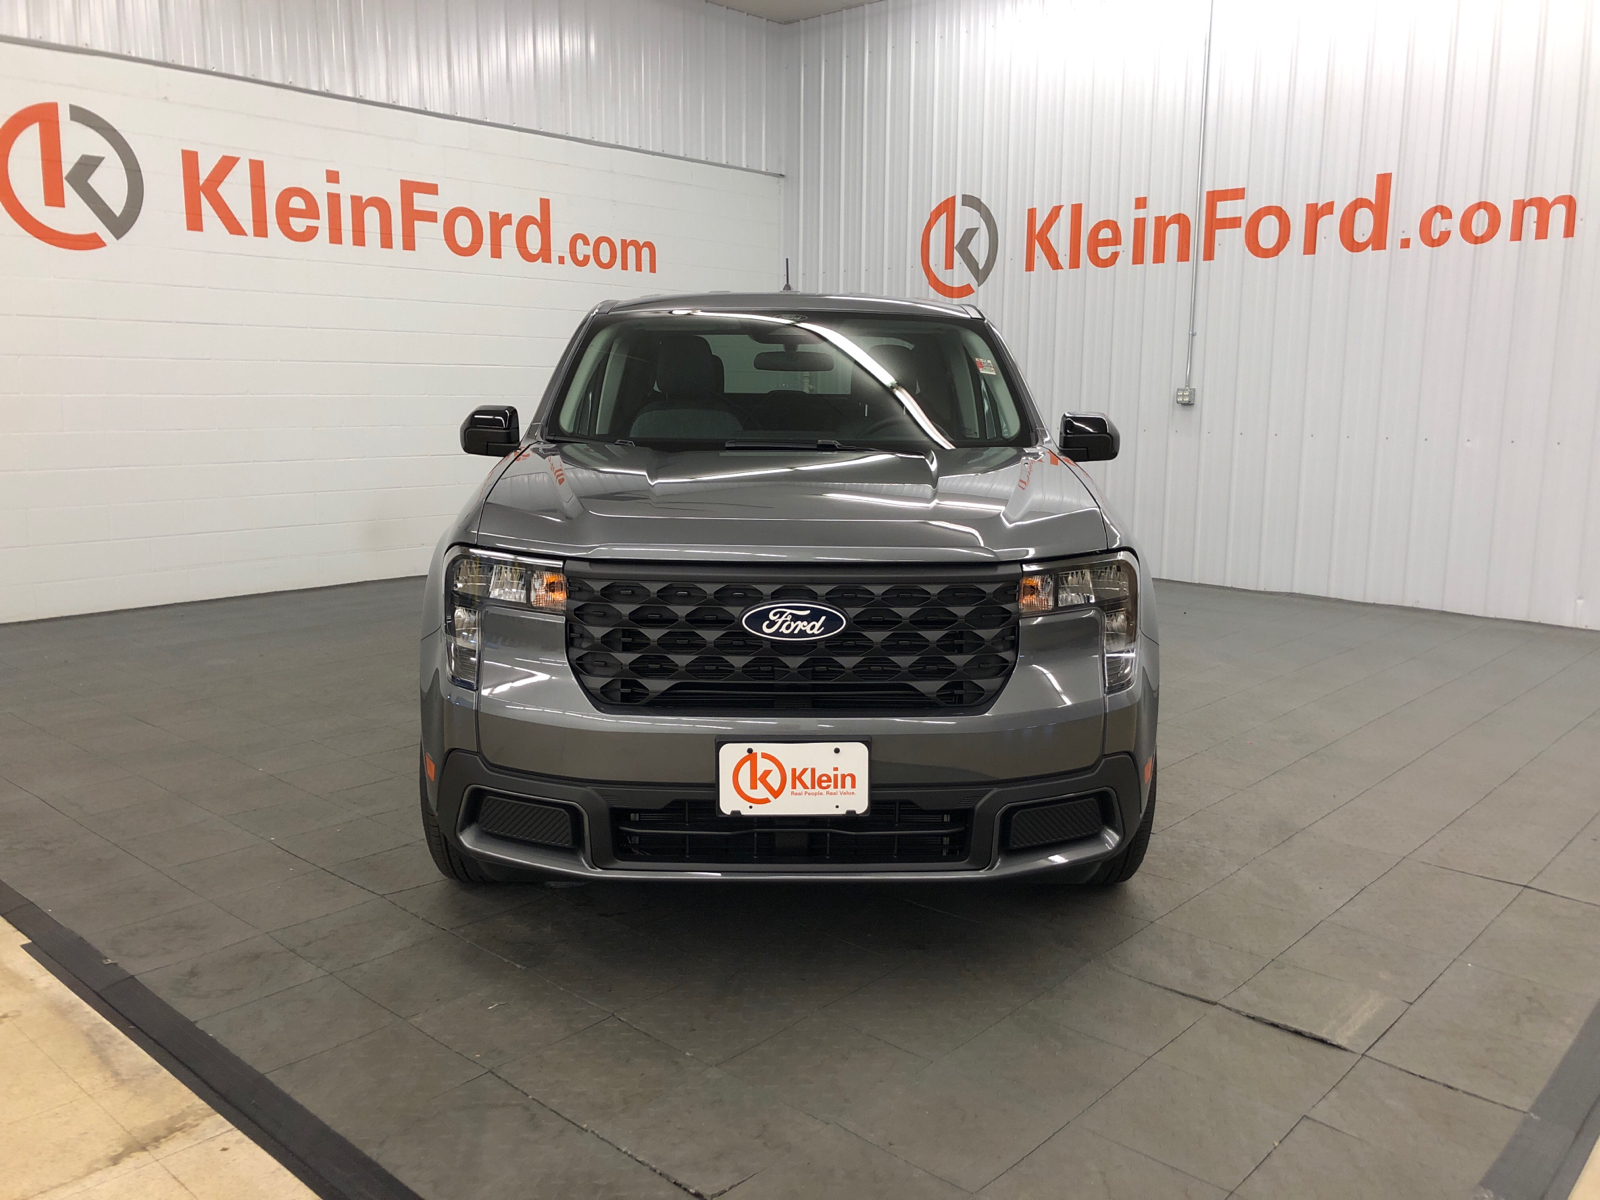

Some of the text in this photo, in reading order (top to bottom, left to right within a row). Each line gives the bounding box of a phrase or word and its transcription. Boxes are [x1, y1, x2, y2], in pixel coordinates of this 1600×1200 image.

[181, 148, 657, 274] KleinFord.com
[1024, 172, 1577, 272] KleinFord.com
[762, 608, 826, 634] Ford
[790, 767, 857, 790] Klein
